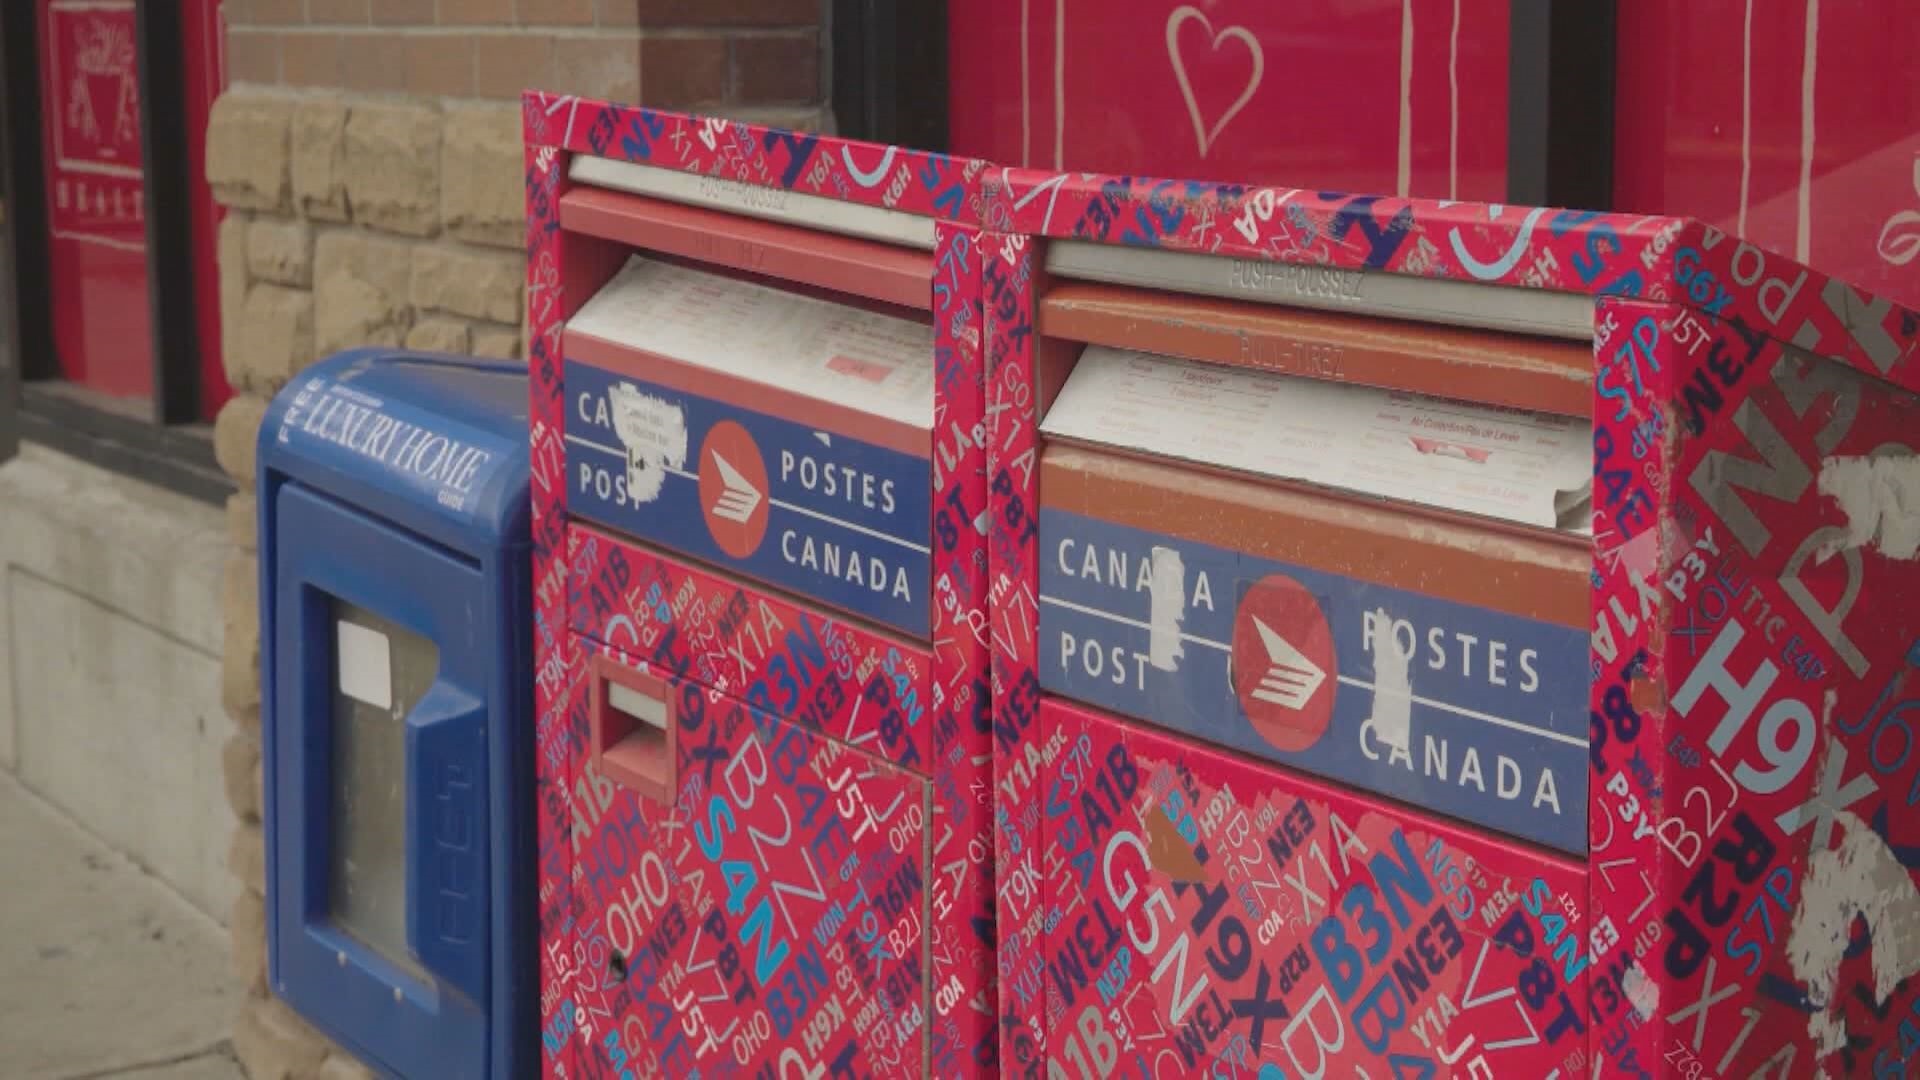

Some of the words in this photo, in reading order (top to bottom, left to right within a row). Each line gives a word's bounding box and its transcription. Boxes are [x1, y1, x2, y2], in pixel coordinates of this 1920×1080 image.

[882, 164, 912, 208] K6H
[1673, 246, 1736, 326] G6X
[1597, 315, 1663, 422] S7P
[278, 376, 325, 443] FREE
[303, 394, 408, 463] LUXURY
[392, 426, 491, 494] HOME
[579, 462, 634, 507] POS
[781, 450, 896, 515] POSTES
[589, 544, 631, 628] A1B
[781, 530, 912, 602] CANADA
[1058, 538, 1215, 612] CANAA
[1664, 525, 1722, 603] P3Y
[728, 598, 785, 687] X1A
[1061, 631, 1151, 690] POST
[1000, 740, 1042, 807] Y1A
[1060, 733, 1093, 796] S7P
[1668, 616, 1882, 862] H9X
[826, 767, 879, 843] J5T
[1081, 741, 1139, 847] A1B
[1266, 797, 1317, 870] E3N
[1605, 770, 1656, 841] P3Y
[1656, 757, 1739, 870] B2J
[723, 730, 828, 942] B2Z
[1225, 809, 1282, 910] B2Z
[1282, 810, 1370, 927] X1A
[693, 793, 805, 997] S4N
[998, 847, 1043, 921] T9K
[1310, 825, 1436, 1007] B3N
[1480, 875, 1520, 930] M3C
[1724, 864, 1796, 979] S7P
[887, 906, 922, 960] B2J
[1103, 829, 1211, 1026] G5N
[1392, 903, 1466, 1006] E3N
[1520, 877, 1592, 985] S4N
[765, 939, 830, 1042] B3N
[1493, 909, 1587, 1045] P8T
[672, 989, 719, 1061] J5T
[1411, 991, 1460, 1049] Y1A
